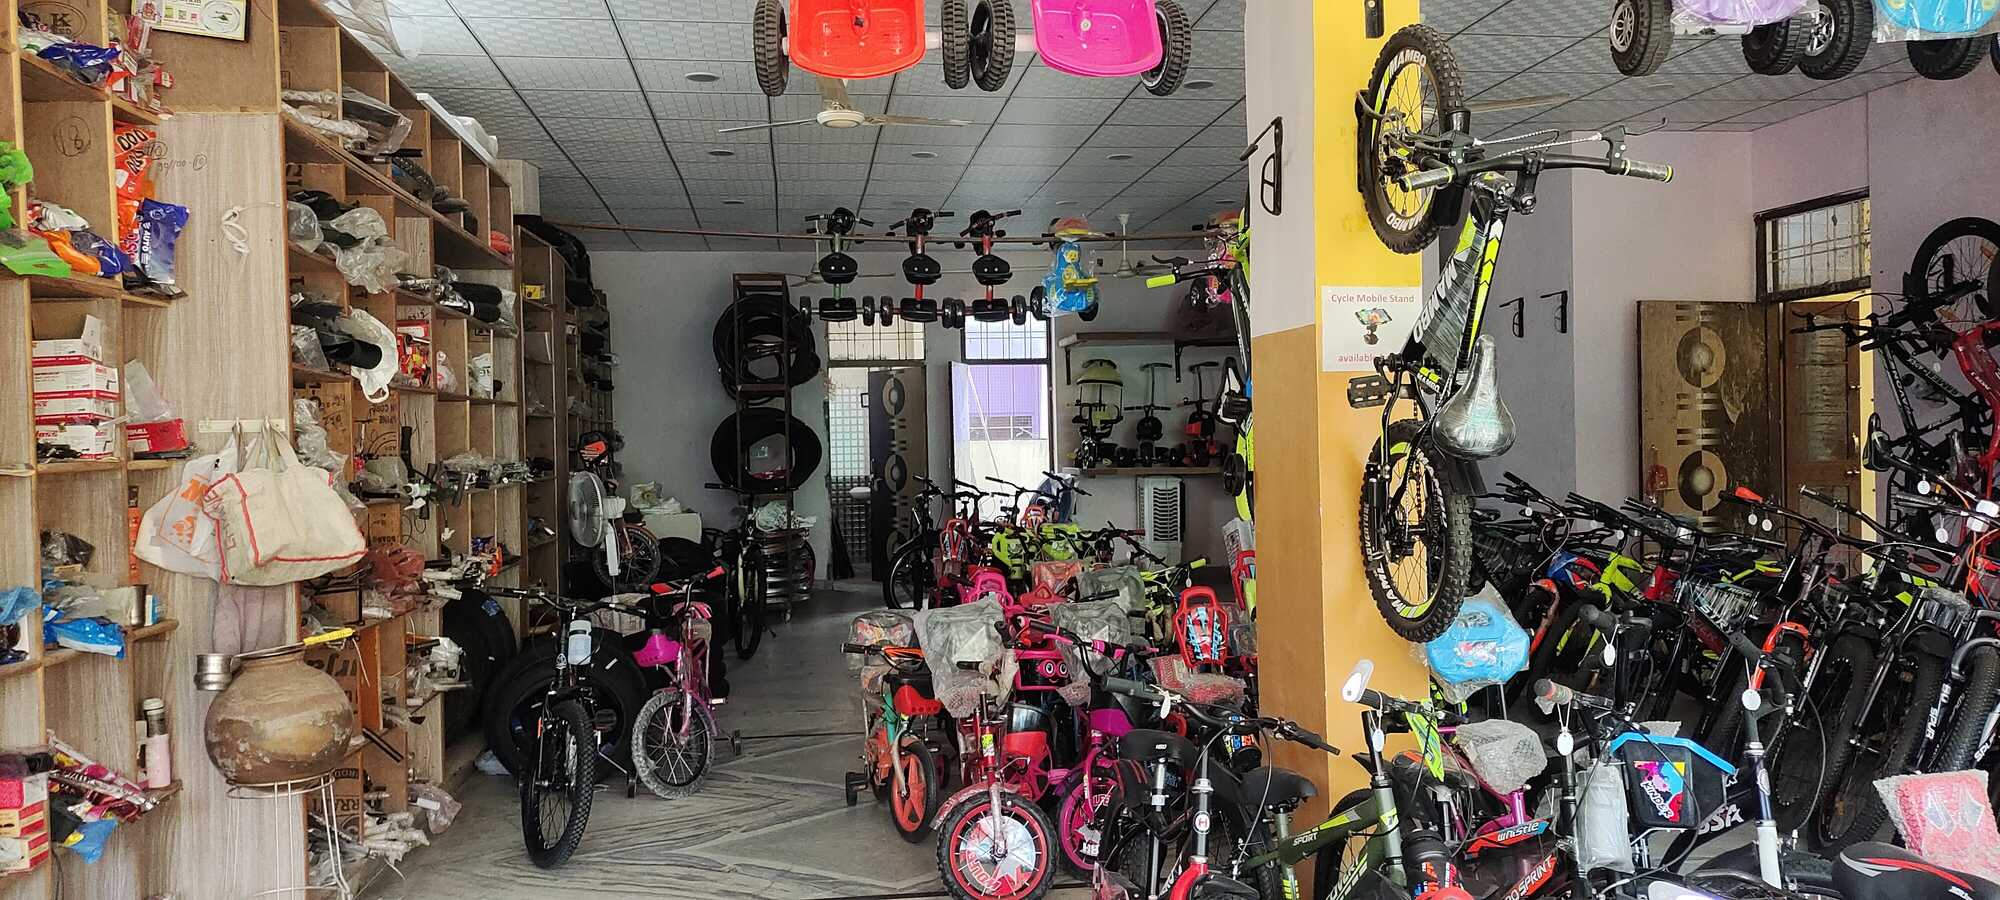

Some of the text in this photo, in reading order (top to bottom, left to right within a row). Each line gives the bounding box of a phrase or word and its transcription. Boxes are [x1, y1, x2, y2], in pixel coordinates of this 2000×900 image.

[1389, 48, 1427, 78] MAMBO
[1331, 294, 1415, 304] Cycle Mobile Stand
[1413, 256, 1458, 344] MAMBO
[1338, 352, 1376, 362] availabl
[1292, 831, 1318, 847] SPORT
[1519, 854, 1553, 897] SPRINT
